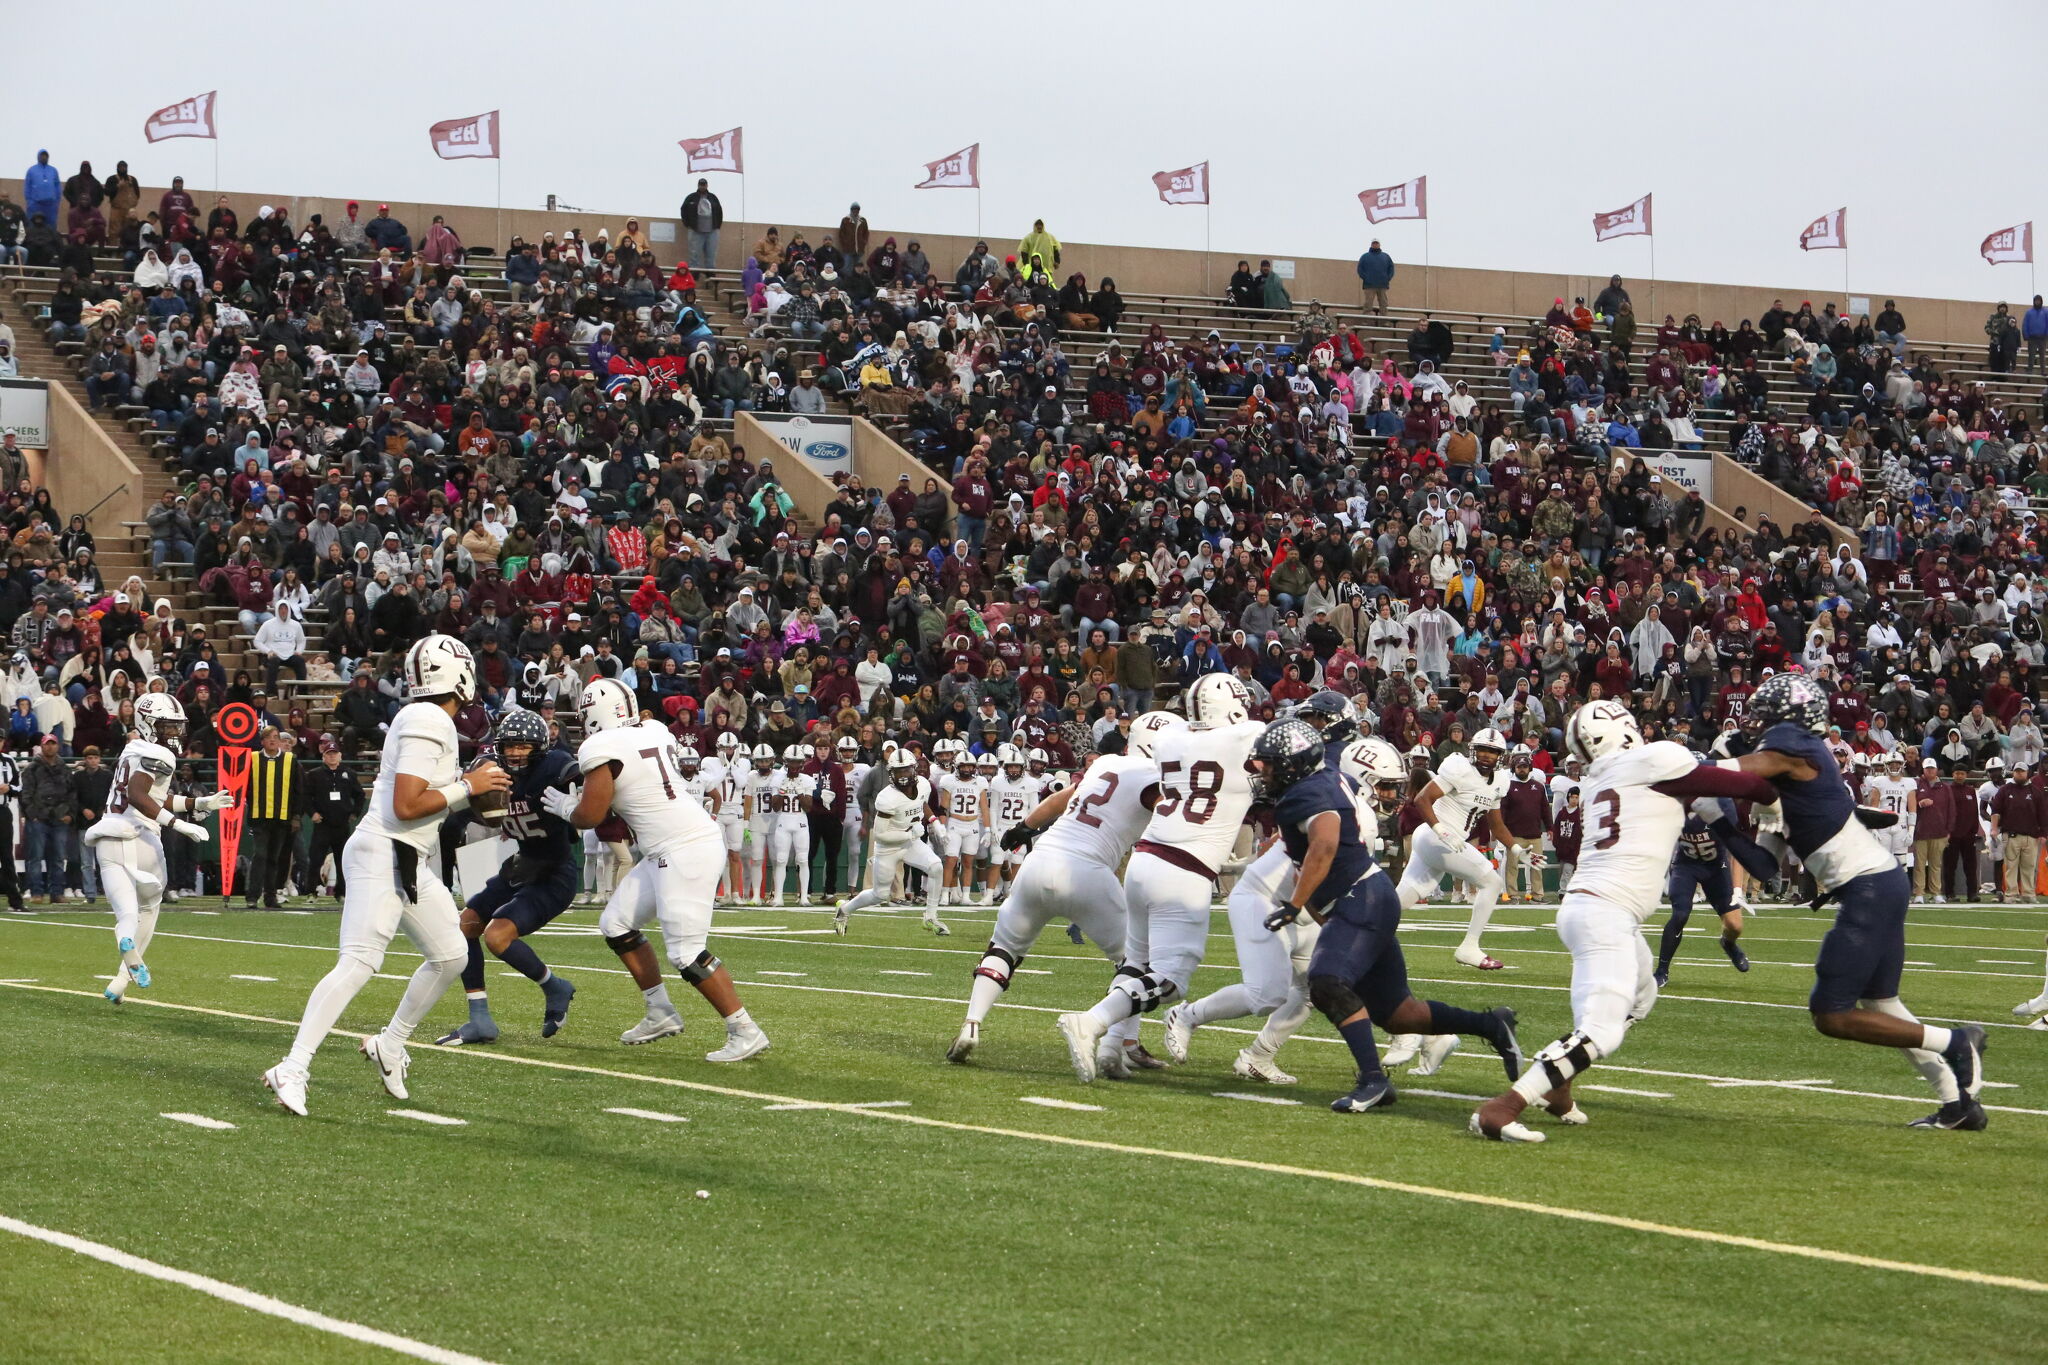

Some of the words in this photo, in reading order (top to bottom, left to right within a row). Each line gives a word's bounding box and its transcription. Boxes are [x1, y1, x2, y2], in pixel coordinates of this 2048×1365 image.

[813, 444, 840, 458] Ford
[1420, 613, 1440, 623] FAM
[1727, 692, 1746, 700] REBELS
[1729, 701, 1743, 717] 79
[105, 756, 131, 815] 8
[1156, 760, 1225, 825] 58
[757, 792, 773, 814] 19
[954, 794, 976, 815] 32
[1002, 798, 1024, 820] 22
[1885, 795, 1902, 814] 31
